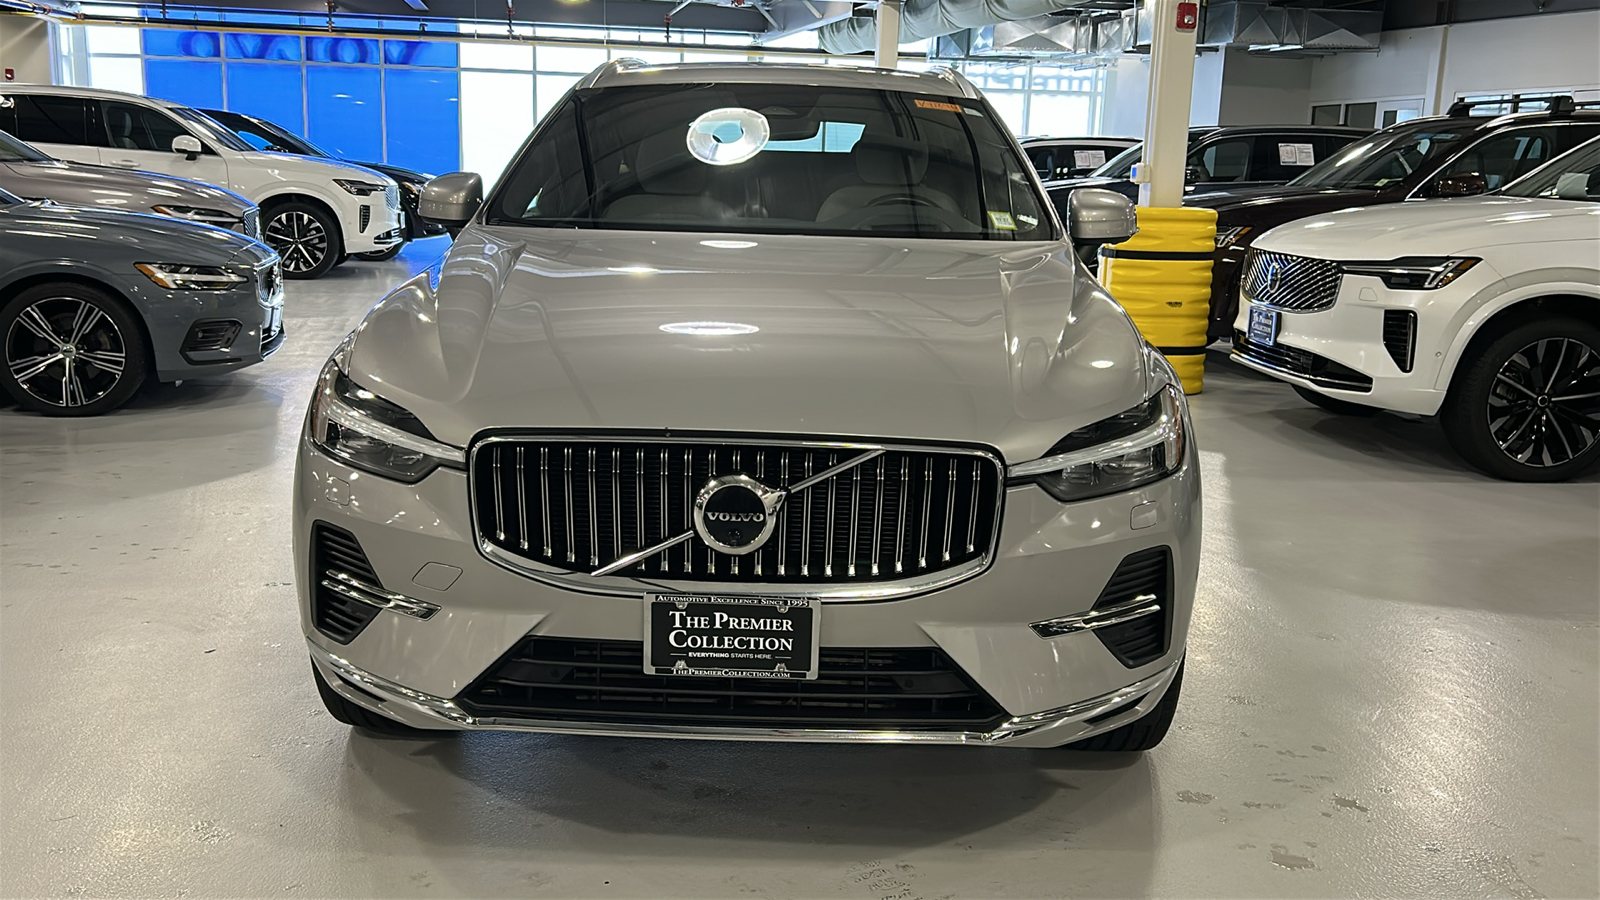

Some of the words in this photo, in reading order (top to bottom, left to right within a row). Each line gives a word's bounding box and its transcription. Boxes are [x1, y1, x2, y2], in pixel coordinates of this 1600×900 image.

[705, 511, 764, 522] VOLVO
[710, 596, 758, 604] EXCELLENCE
[669, 611, 710, 629] THE
[713, 612, 794, 631] PREMIER
[668, 629, 794, 651] COLLECTION
